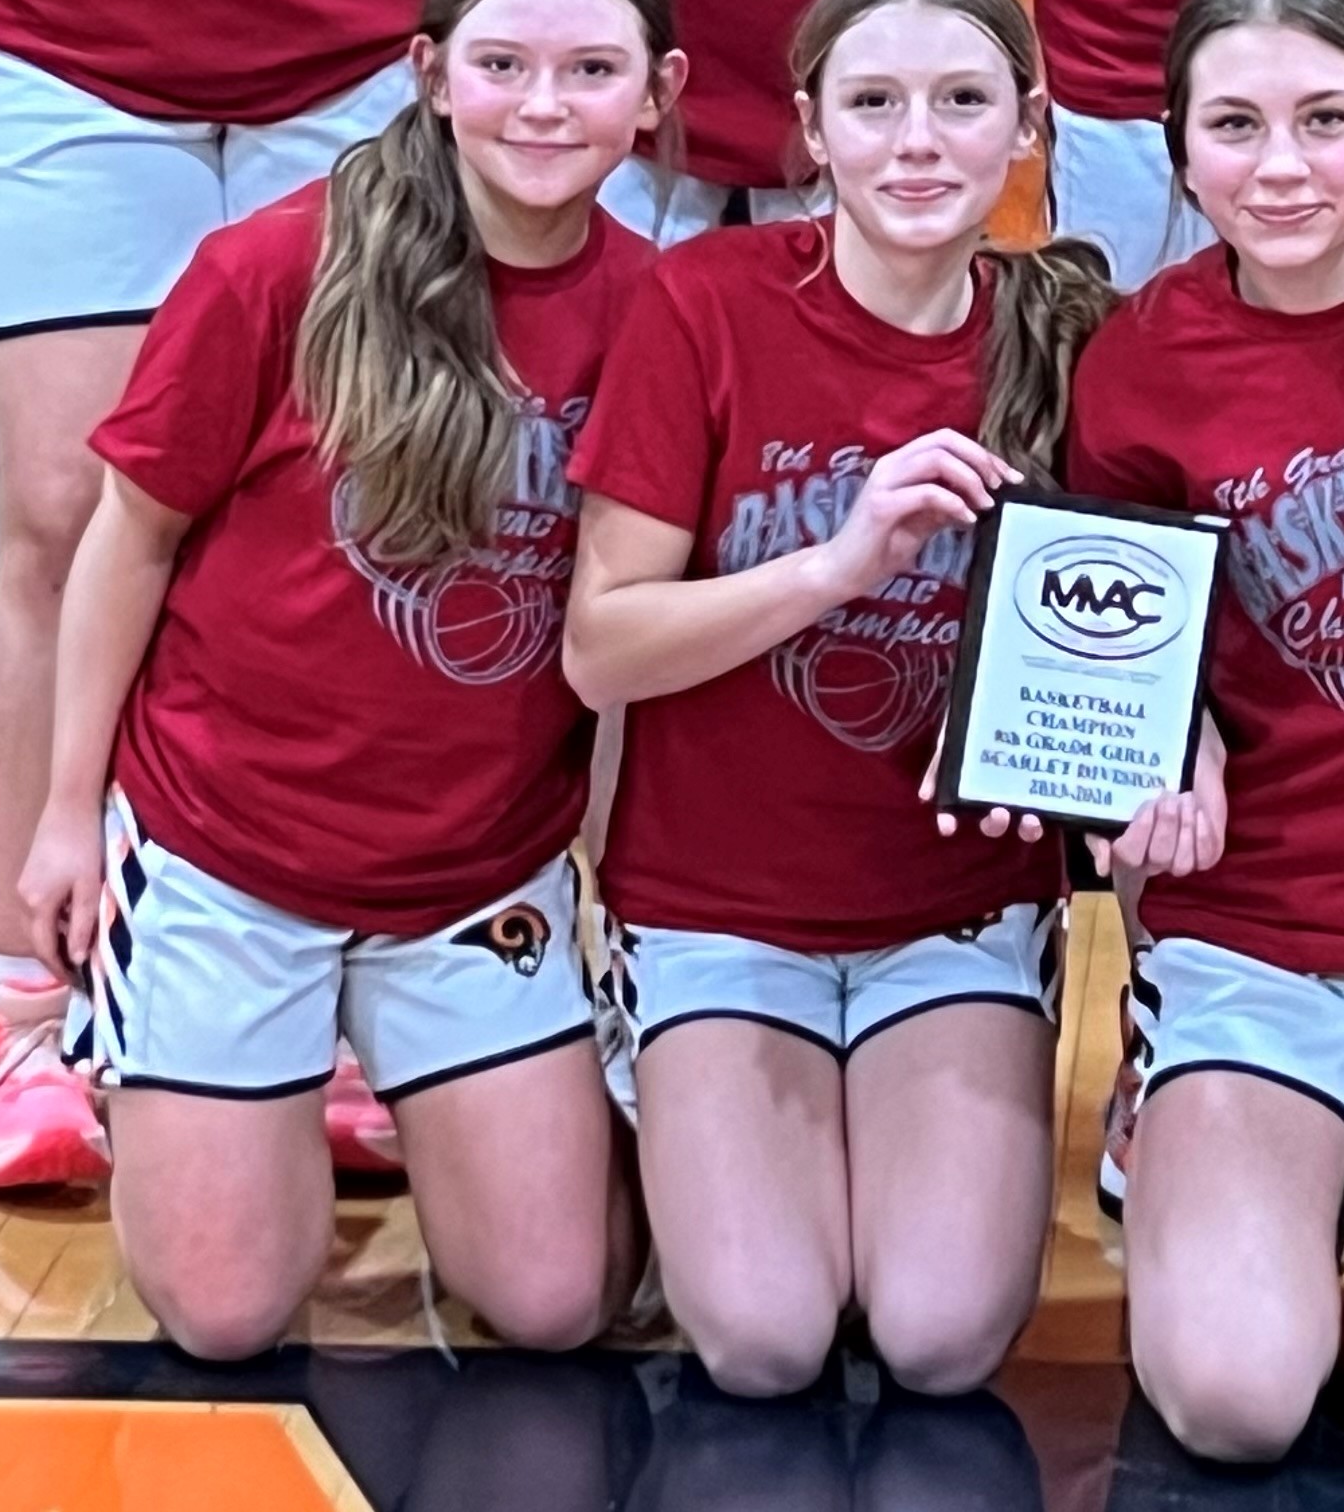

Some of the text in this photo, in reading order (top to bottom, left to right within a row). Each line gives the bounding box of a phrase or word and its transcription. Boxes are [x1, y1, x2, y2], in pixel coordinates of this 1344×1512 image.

[1019, 686, 1146, 719] BASKETBALL
[1026, 710, 1135, 739] CHAMPION
[980, 749, 1167, 789] SCARLET DIVISION
[1100, 744, 1161, 767] GIRLS
